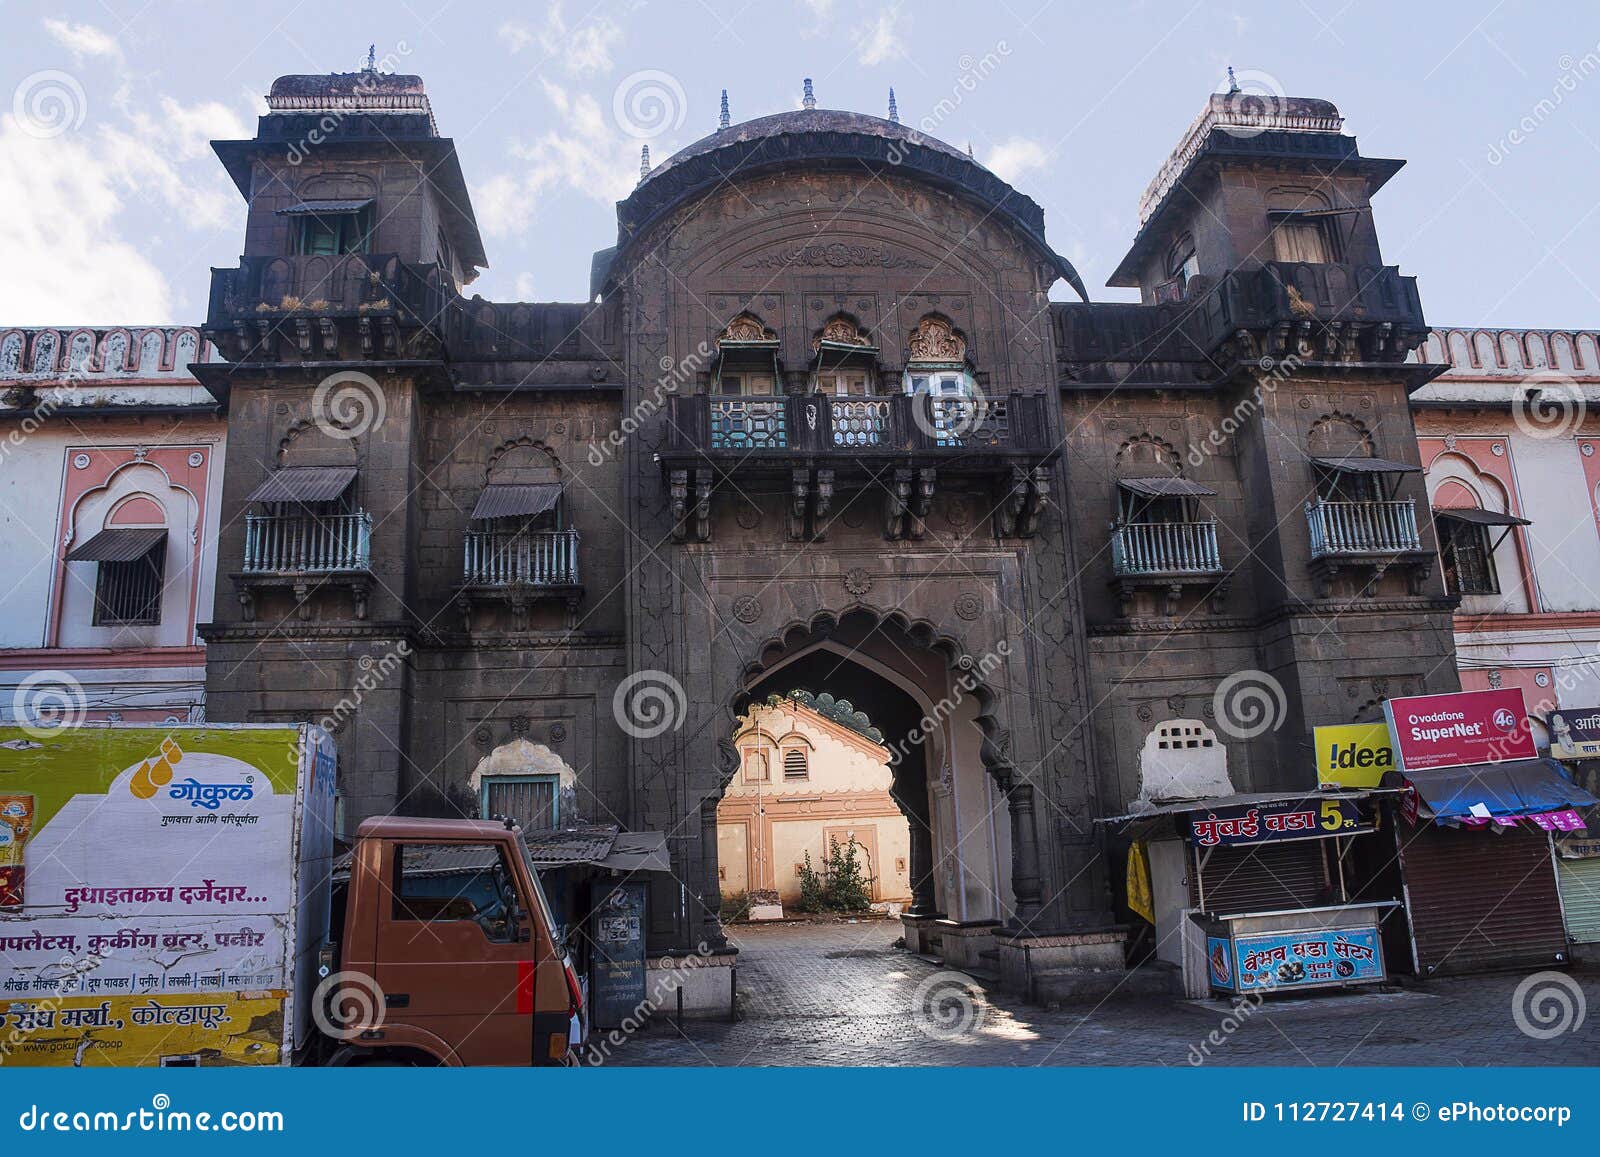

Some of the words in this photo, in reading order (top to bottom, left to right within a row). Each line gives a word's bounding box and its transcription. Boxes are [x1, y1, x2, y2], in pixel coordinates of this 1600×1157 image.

[1418, 711, 1464, 723] vodafone
[1495, 712, 1513, 727] 4G
[169, 777, 253, 810] गोकुळ
[161, 814, 193, 827] गुणवत्ता
[195, 813, 218, 824] आणि
[220, 813, 259, 827] परिपूर्णता
[1193, 809, 1259, 846] मुंबई
[1264, 811, 1315, 832] वडा
[1320, 800, 1343, 831] 5
[65, 887, 175, 912] दुधाइतकच
[215, 926, 265, 947] पनीर
[1292, 941, 1328, 958] वडा
[88, 978, 101, 992] दूध
[104, 978, 129, 988] पावडर
